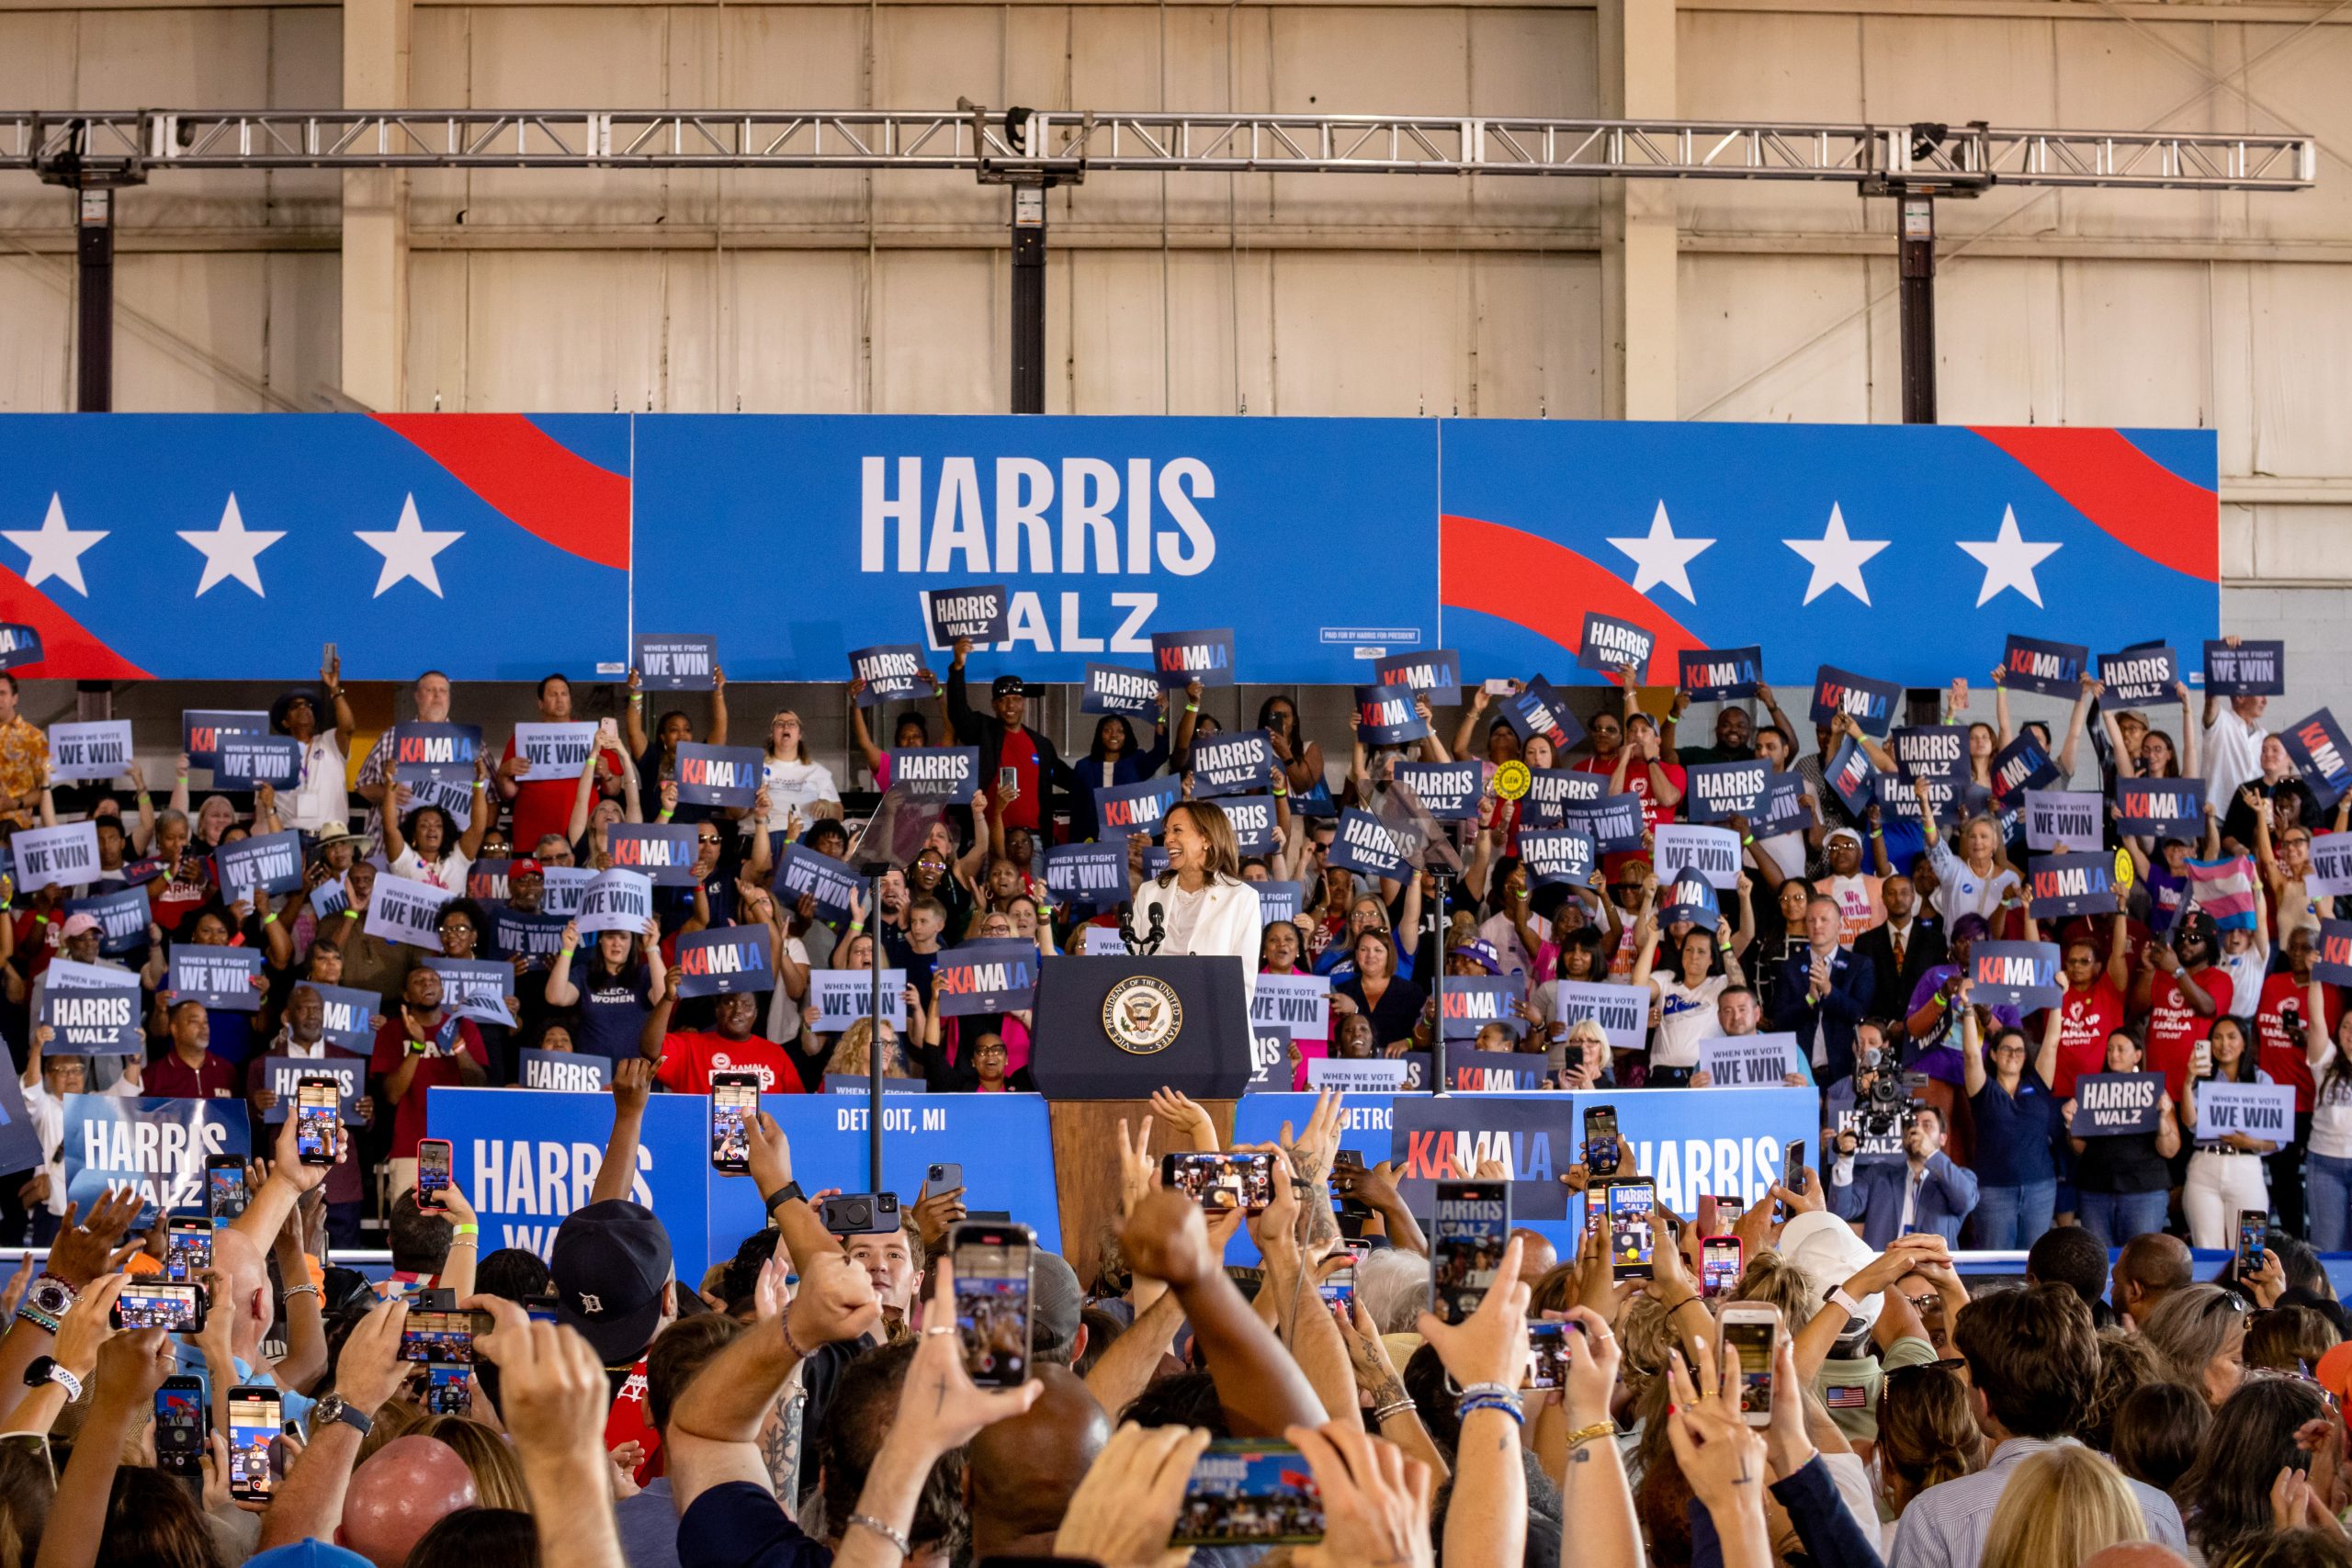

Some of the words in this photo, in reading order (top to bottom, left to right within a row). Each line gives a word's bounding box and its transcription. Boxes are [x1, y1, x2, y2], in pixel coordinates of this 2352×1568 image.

[862, 457, 1216, 576] HARRIS
[936, 595, 998, 623] HARRIS
[947, 622, 989, 636] WALZ
[1590, 622, 1649, 660] HARRIS
[644, 654, 670, 675] WE
[673, 654, 708, 675] WIN
[857, 653, 918, 681] HARRIS
[1160, 645, 1227, 671] KAMALA
[2010, 649, 2077, 682] KAMALA
[2211, 660, 2236, 682] WE
[2240, 660, 2274, 682] WIN
[1094, 671, 1159, 699] HARRIS
[1686, 660, 1756, 688] KAMALA
[2104, 657, 2170, 687] HARRIS
[872, 678, 913, 694] WALZ
[2117, 683, 2162, 700] WALZ
[1102, 696, 1146, 710] WALZ
[59, 744, 84, 764] WE
[88, 741, 123, 763] WIN
[225, 745, 248, 753] WHEN
[400, 737, 472, 763] KAMALA
[526, 744, 551, 764] WE
[556, 743, 590, 763] WIN
[1196, 739, 1264, 772] HARRIS
[1900, 735, 1960, 761] HARRIS
[224, 755, 251, 776] WE
[254, 756, 291, 778] WIN
[682, 757, 754, 789] KAMALA
[899, 755, 968, 779] HARRIS
[1209, 766, 1257, 784] WALZ
[1908, 761, 1950, 775] WALZ
[910, 782, 957, 794] WALZ
[1404, 771, 1473, 795] HARRIS
[1532, 776, 1599, 799] HARRIS
[1697, 770, 1765, 798] HARRIS
[1105, 795, 1174, 826] KAMALA
[1415, 796, 1462, 809] WALZ
[1541, 803, 1562, 817] WA
[1710, 797, 1755, 812] WALZ
[2125, 793, 2197, 818] KAMALA
[1594, 814, 1634, 840] WIN
[2034, 812, 2053, 834] WE
[2058, 814, 2092, 835] WIN
[24, 841, 48, 850] WHEN
[51, 838, 62, 846] WE
[64, 835, 85, 844] VOTE
[1344, 819, 1416, 858] HARRIS
[1521, 837, 1589, 863] HARRIS
[25, 850, 51, 875] WE
[54, 844, 90, 871] WIN
[615, 839, 688, 865] KAMALA
[1049, 855, 1073, 864] WHEN
[1075, 855, 1088, 863] WE
[1091, 854, 1116, 863] FIGHT
[1351, 847, 1404, 870] WALZ
[1666, 847, 1692, 869] WE
[1698, 849, 1734, 872] WIN
[226, 861, 255, 886] WE
[258, 852, 293, 880] WIN
[1048, 865, 1074, 890] WE
[1078, 865, 1118, 889] WIN
[1534, 862, 1581, 874] WALZ
[2314, 856, 2340, 880] WE
[785, 864, 817, 895] WE
[819, 880, 852, 910] WIN
[2035, 867, 2108, 898] KAMALA
[582, 896, 605, 915] WE
[610, 889, 643, 916] WIN
[107, 909, 143, 938] WIN
[498, 928, 525, 952] WE
[682, 943, 763, 976] KAMALA
[1978, 955, 2055, 987] KAMALA
[178, 967, 207, 991] WE
[211, 969, 249, 993] WIN
[947, 961, 1030, 995] KAMALA
[591, 994, 635, 1003] WOMEN
[822, 993, 851, 1016] WE
[1105, 984, 1126, 1029] PRESIDENT
[1159, 984, 1180, 1016] UNITED
[1570, 994, 1596, 1003] WHEN
[53, 998, 130, 1026] HARRIS
[323, 1001, 369, 1032] MALA
[1566, 1004, 1594, 1029] WE
[1598, 1007, 1637, 1031] WIN
[2086, 1014, 2100, 1025] UP
[66, 1029, 119, 1043] WALZ
[1112, 1031, 1130, 1049] VICE
[1155, 1021, 1180, 1049] STATES
[1713, 1050, 1740, 1058] WHEN
[1743, 1048, 1758, 1056] WE
[1759, 1046, 1783, 1055] VOTE
[526, 1060, 601, 1091] HARRIS
[1458, 1067, 1535, 1091] KAMALA
[1712, 1060, 1741, 1085] WE
[1747, 1056, 1787, 1083] WIN
[2083, 1081, 2154, 1109] HARRIS
[837, 1109, 917, 1134] DETOIT,
[923, 1109, 945, 1131] MI
[2095, 1110, 2141, 1125] WALZ
[2210, 1105, 2237, 1127] WE
[2244, 1108, 2282, 1129] WIN
[84, 1119, 227, 1174] HARRIS
[1408, 1131, 1553, 1180] KAMALA
[1628, 1136, 1780, 1213] HARRIS
[107, 1178, 202, 1207] WALZ
[1616, 1190, 1653, 1202] HARRIS
